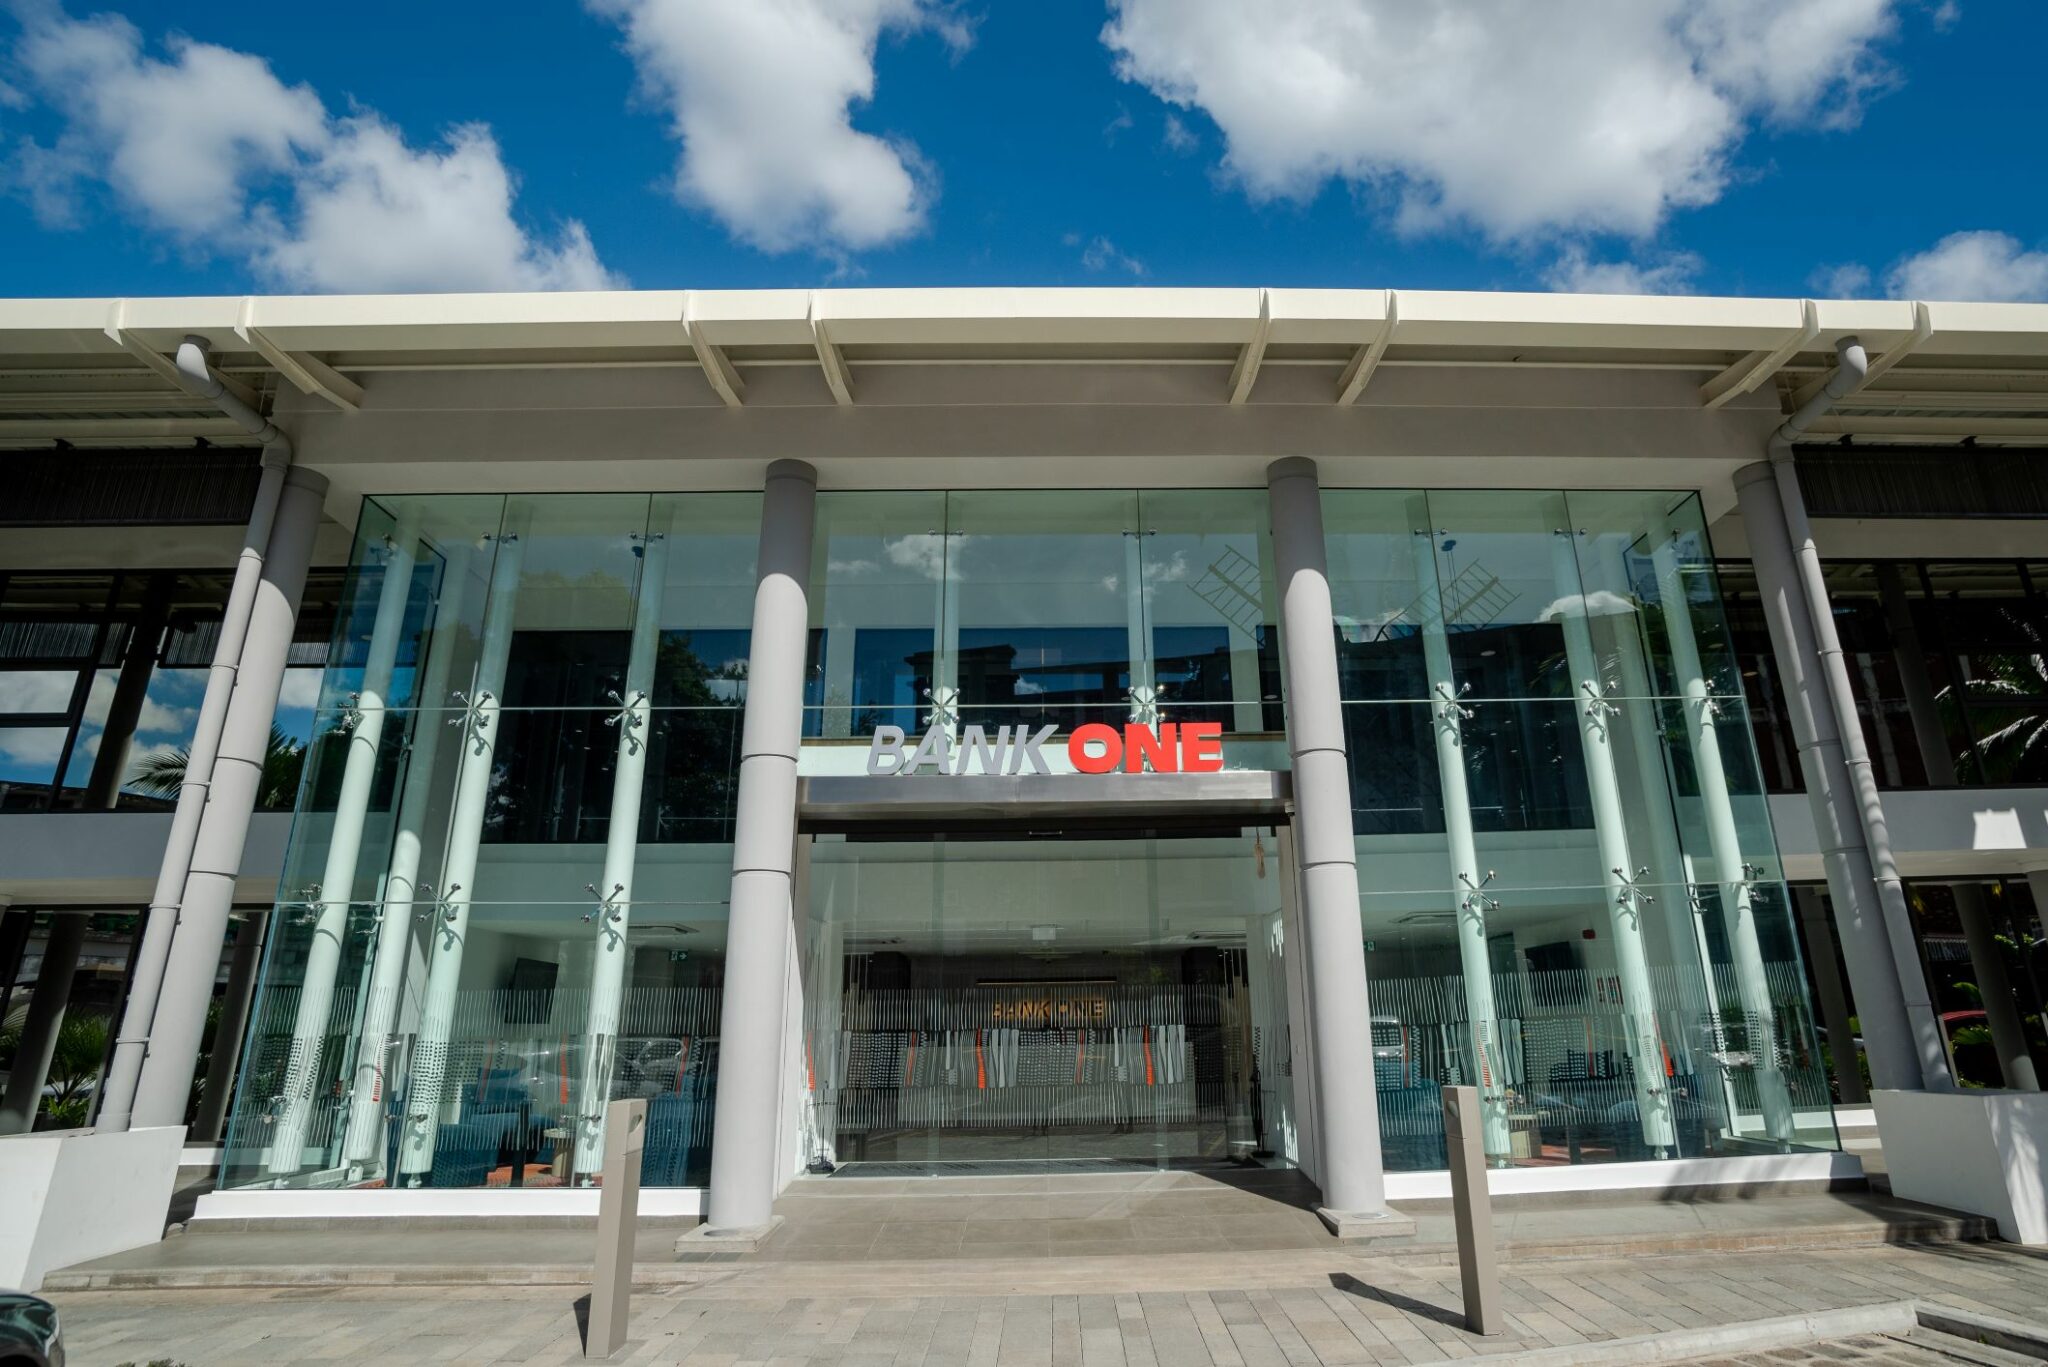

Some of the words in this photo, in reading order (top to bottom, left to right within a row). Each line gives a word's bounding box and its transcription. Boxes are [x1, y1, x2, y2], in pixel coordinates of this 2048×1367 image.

[866, 725, 1059, 775] BANK
[1068, 722, 1224, 774] ONE
[992, 1001, 1051, 1018] BANK
